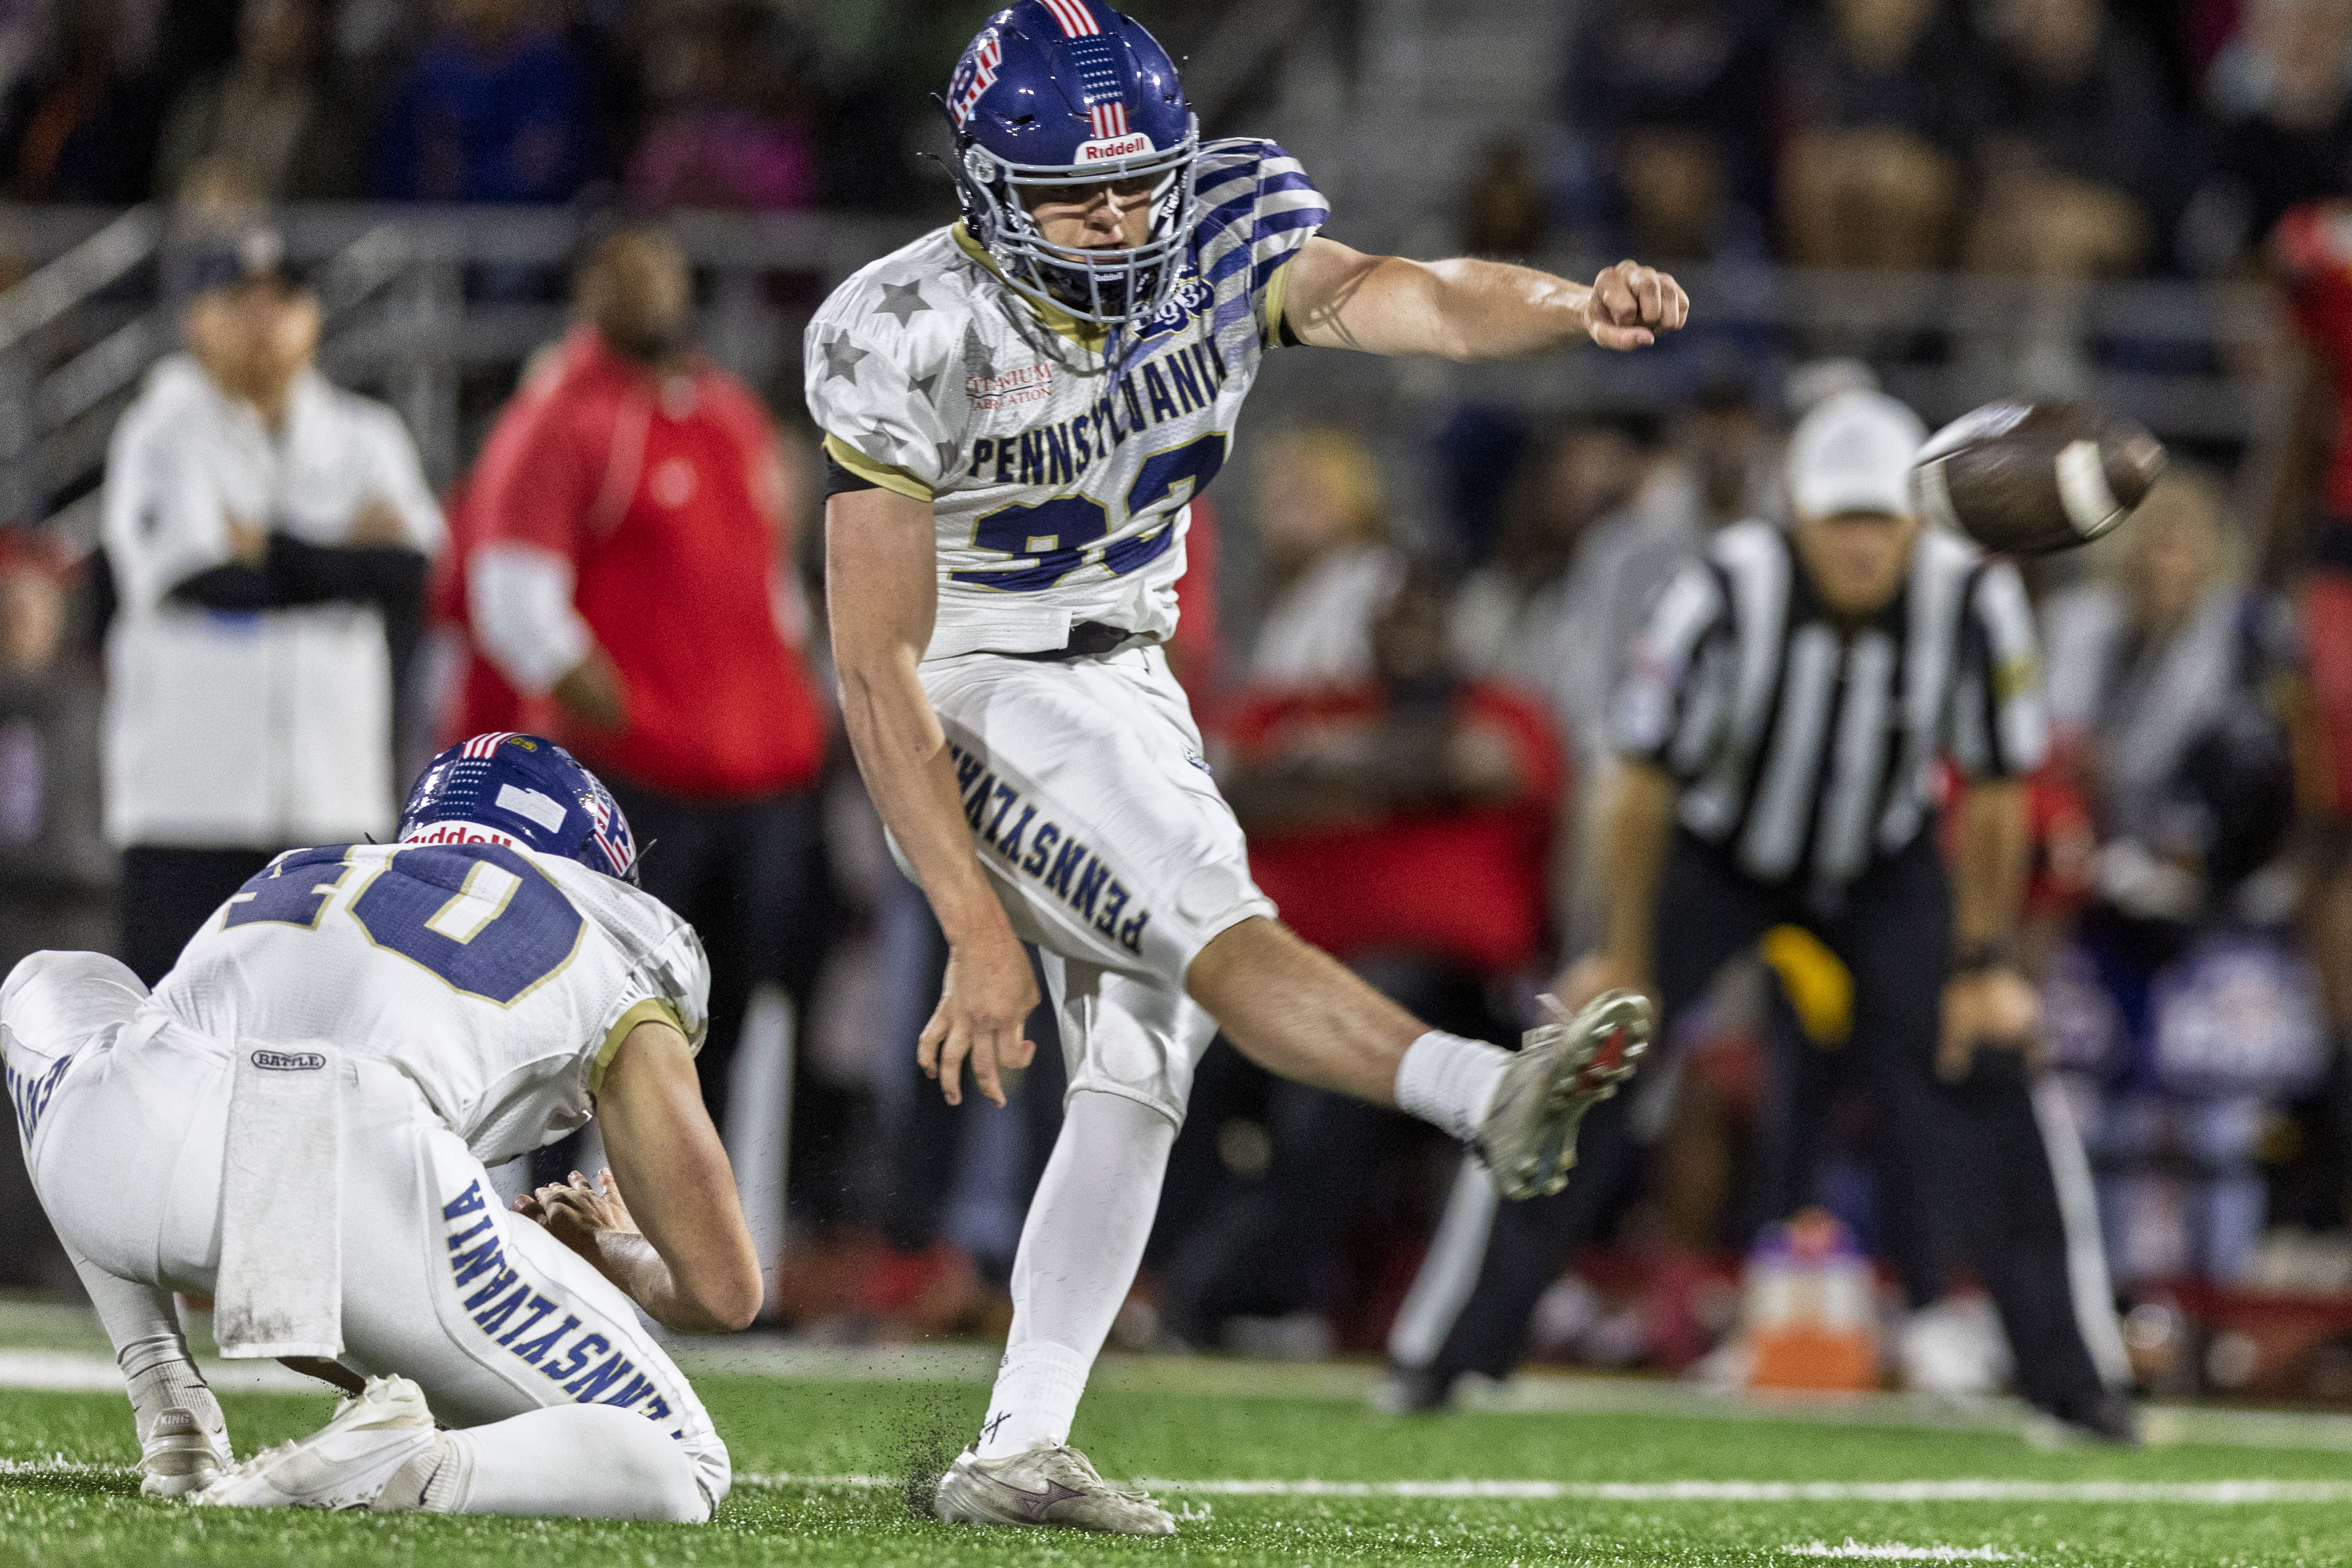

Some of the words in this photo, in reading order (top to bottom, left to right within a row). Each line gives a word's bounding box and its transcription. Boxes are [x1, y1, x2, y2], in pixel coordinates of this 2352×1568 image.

[1085, 137, 1145, 160] Riddell
[965, 363, 1052, 394] ITAIUM
[946, 739, 1150, 956] PENNSYLVA
[218, 843, 588, 1009] 40
[259, 1053, 319, 1067] BATTLE
[442, 1178, 684, 1440] NNSYLVANIA
